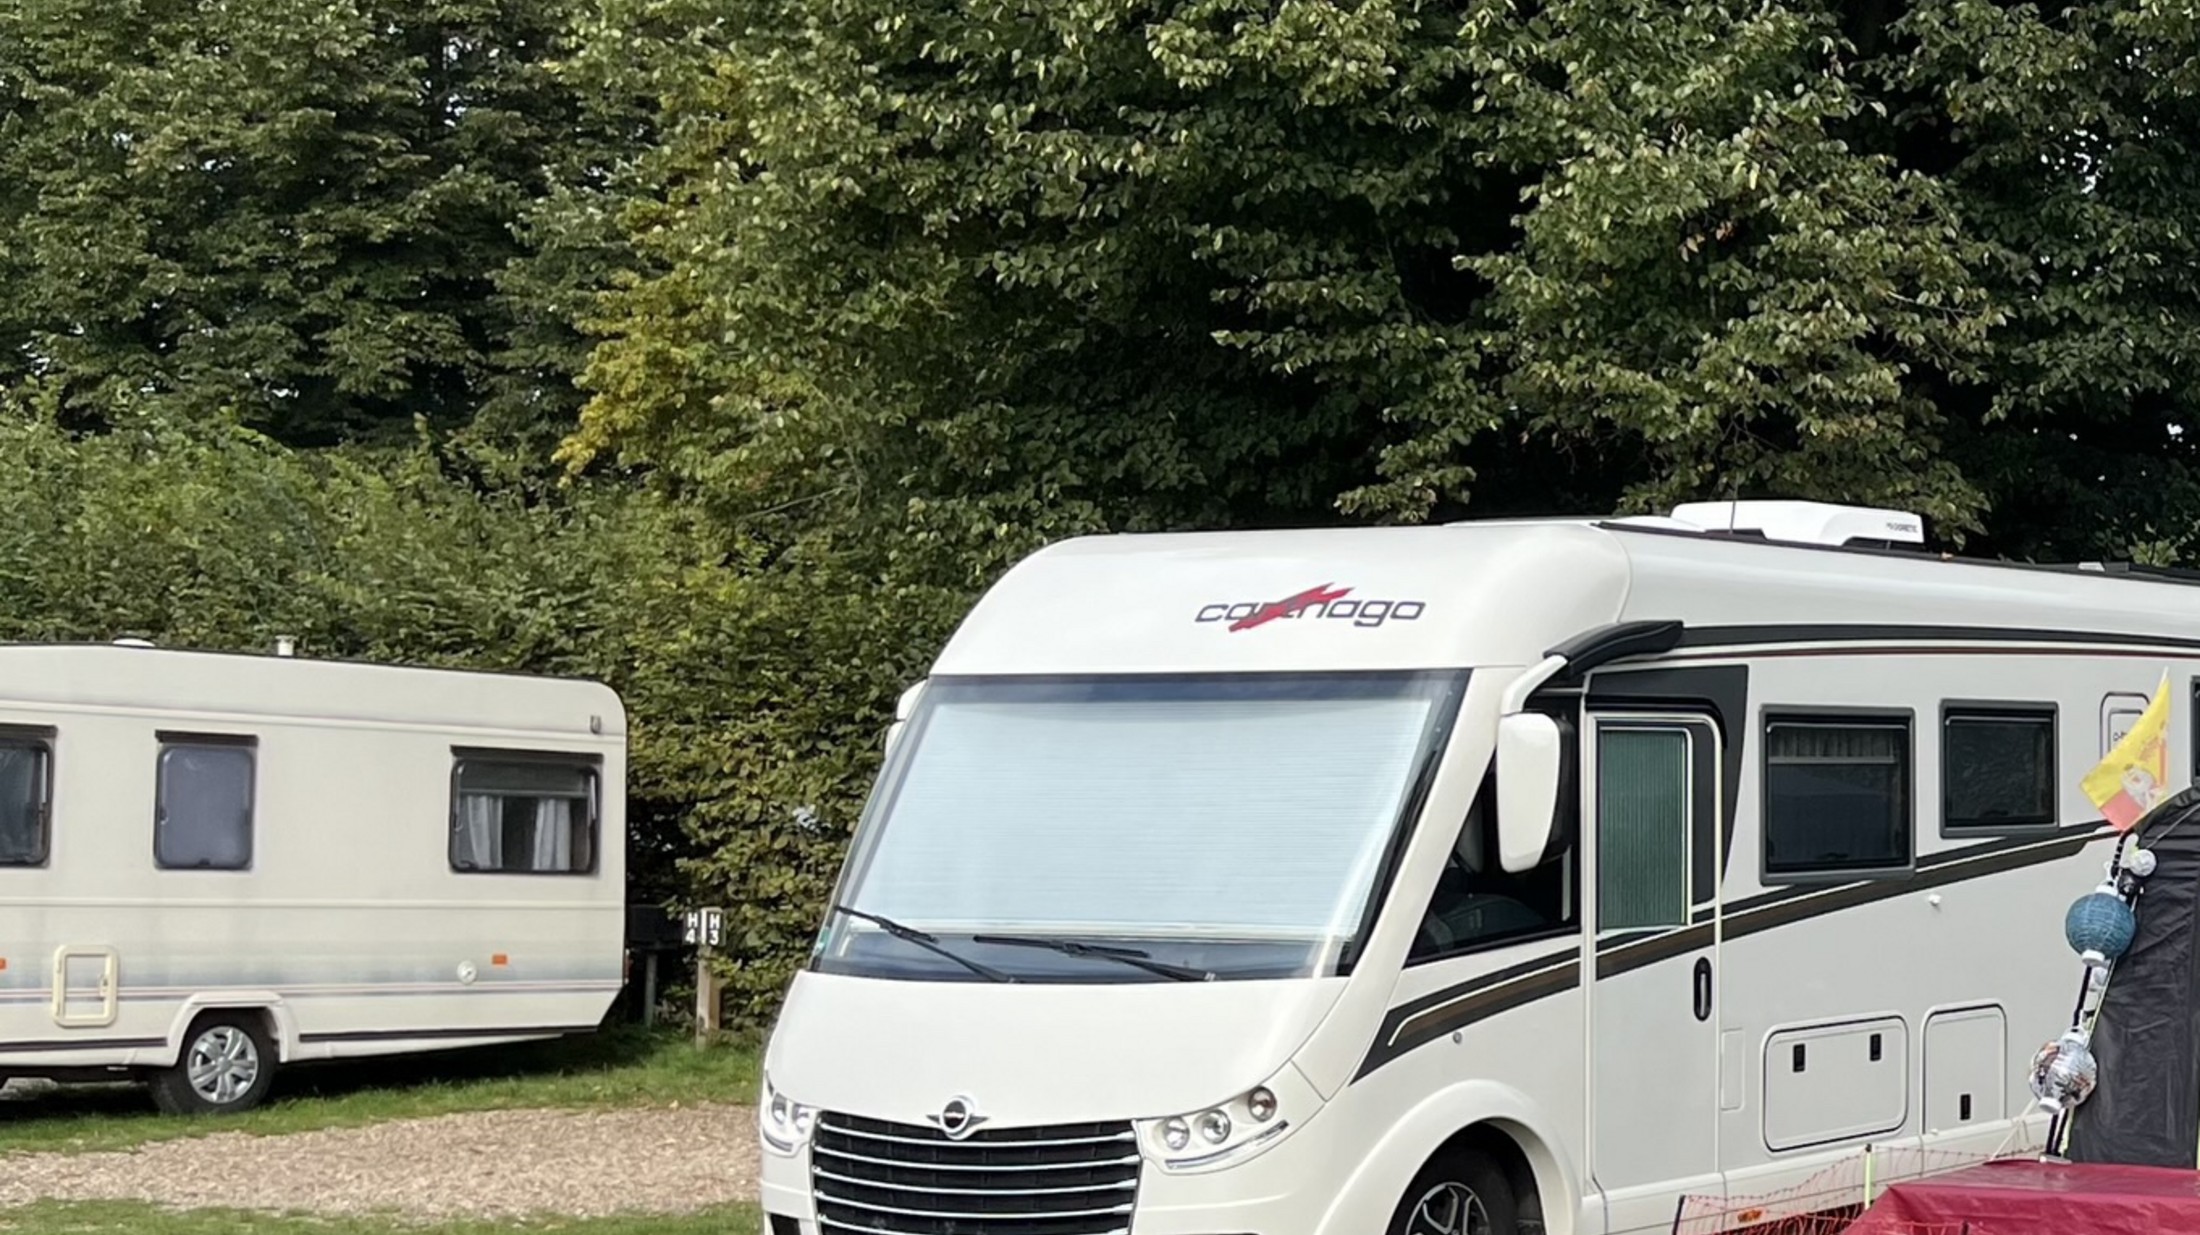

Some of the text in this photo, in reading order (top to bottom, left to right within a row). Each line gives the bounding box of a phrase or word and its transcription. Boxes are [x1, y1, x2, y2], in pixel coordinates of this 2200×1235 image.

[687, 912, 698, 928] H
[709, 913, 720, 930] H
[685, 928, 696, 944] 4
[709, 929, 719, 945] 3
